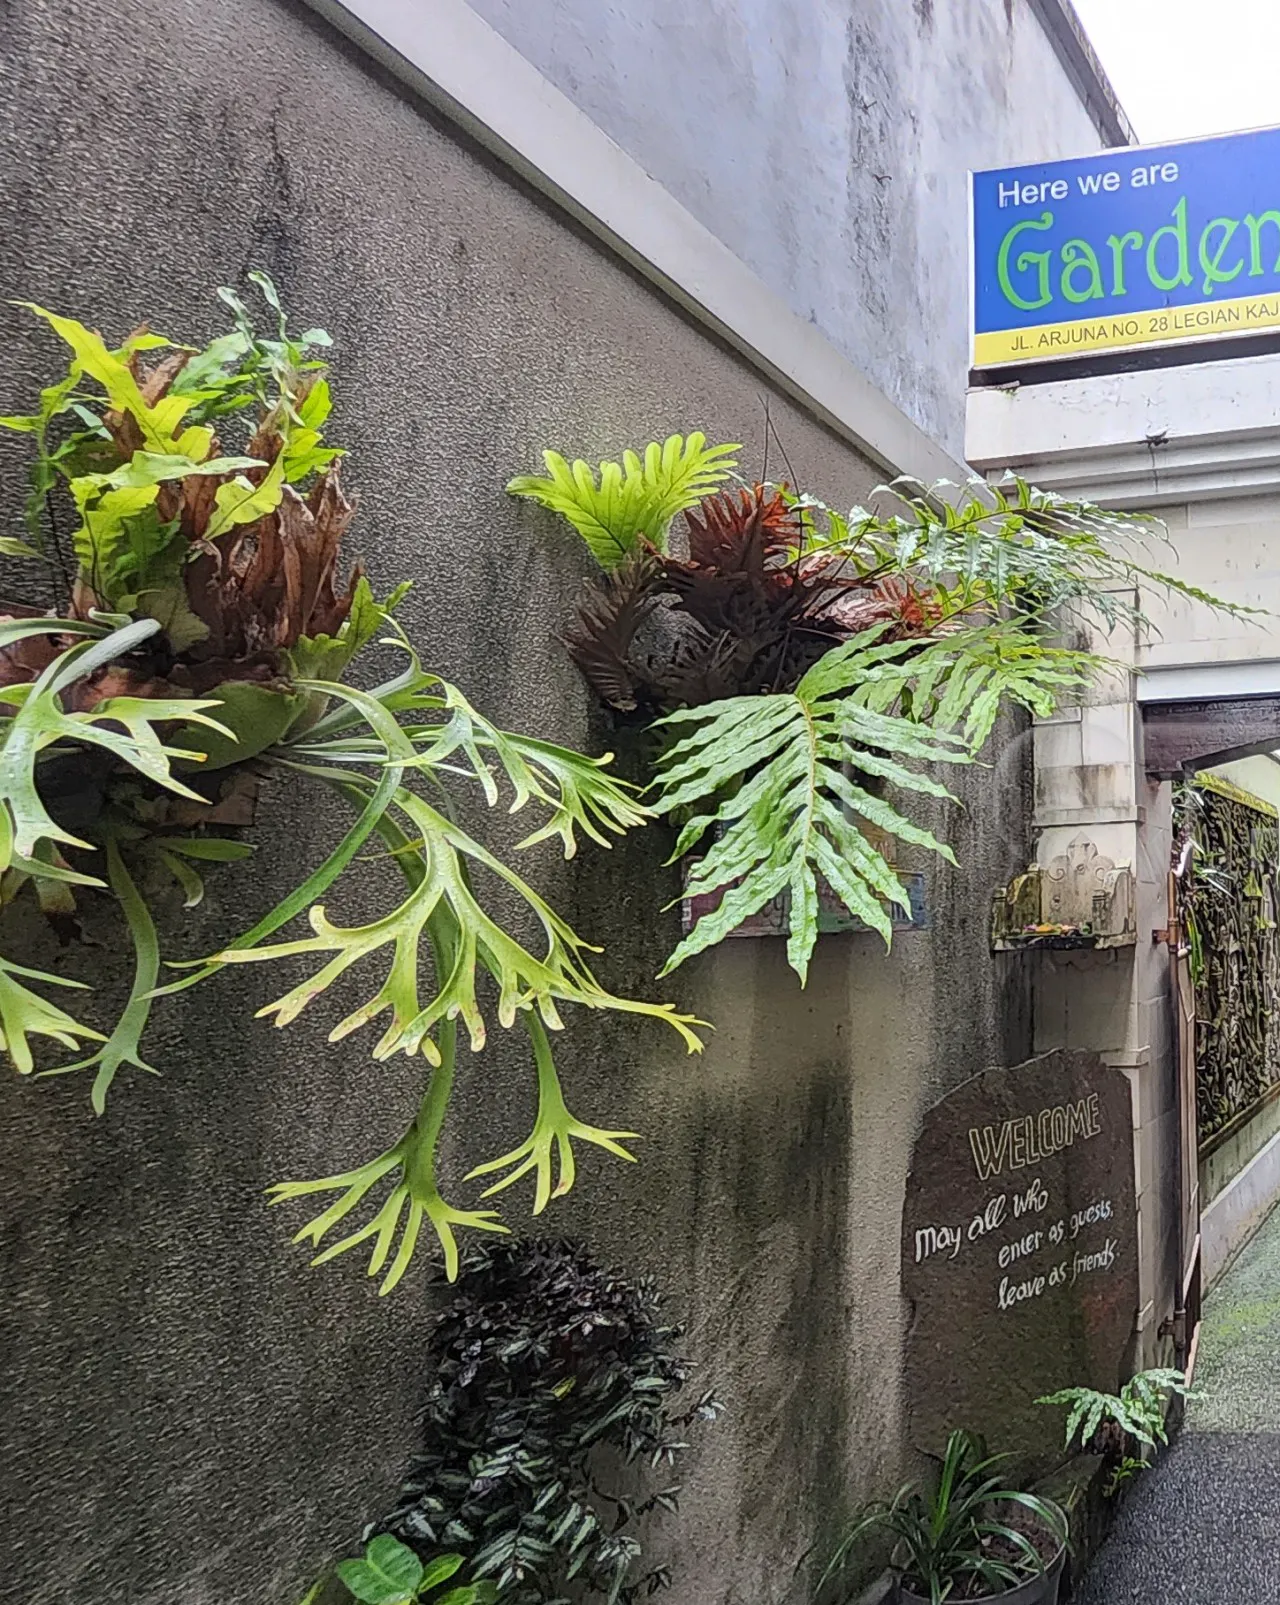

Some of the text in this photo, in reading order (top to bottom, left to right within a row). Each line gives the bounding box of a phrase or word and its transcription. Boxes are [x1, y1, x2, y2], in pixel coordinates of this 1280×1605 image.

[998, 162, 1180, 208] Here we are
[1011, 336, 1034, 351] JL.
[1038, 325, 1108, 347] ARJUNA
[1112, 320, 1144, 340] NO.
[1149, 317, 1169, 332] 28
[1174, 306, 1240, 329] LEGIAN
[968, 1092, 1101, 1181] WELCOME
[968, 1194, 1008, 1241] all
[1013, 1178, 1049, 1219] who
[998, 1230, 1043, 1268] enter
[1048, 1219, 1064, 1246] as
[997, 1276, 1045, 1310] leave
[1048, 1261, 1068, 1287] as
